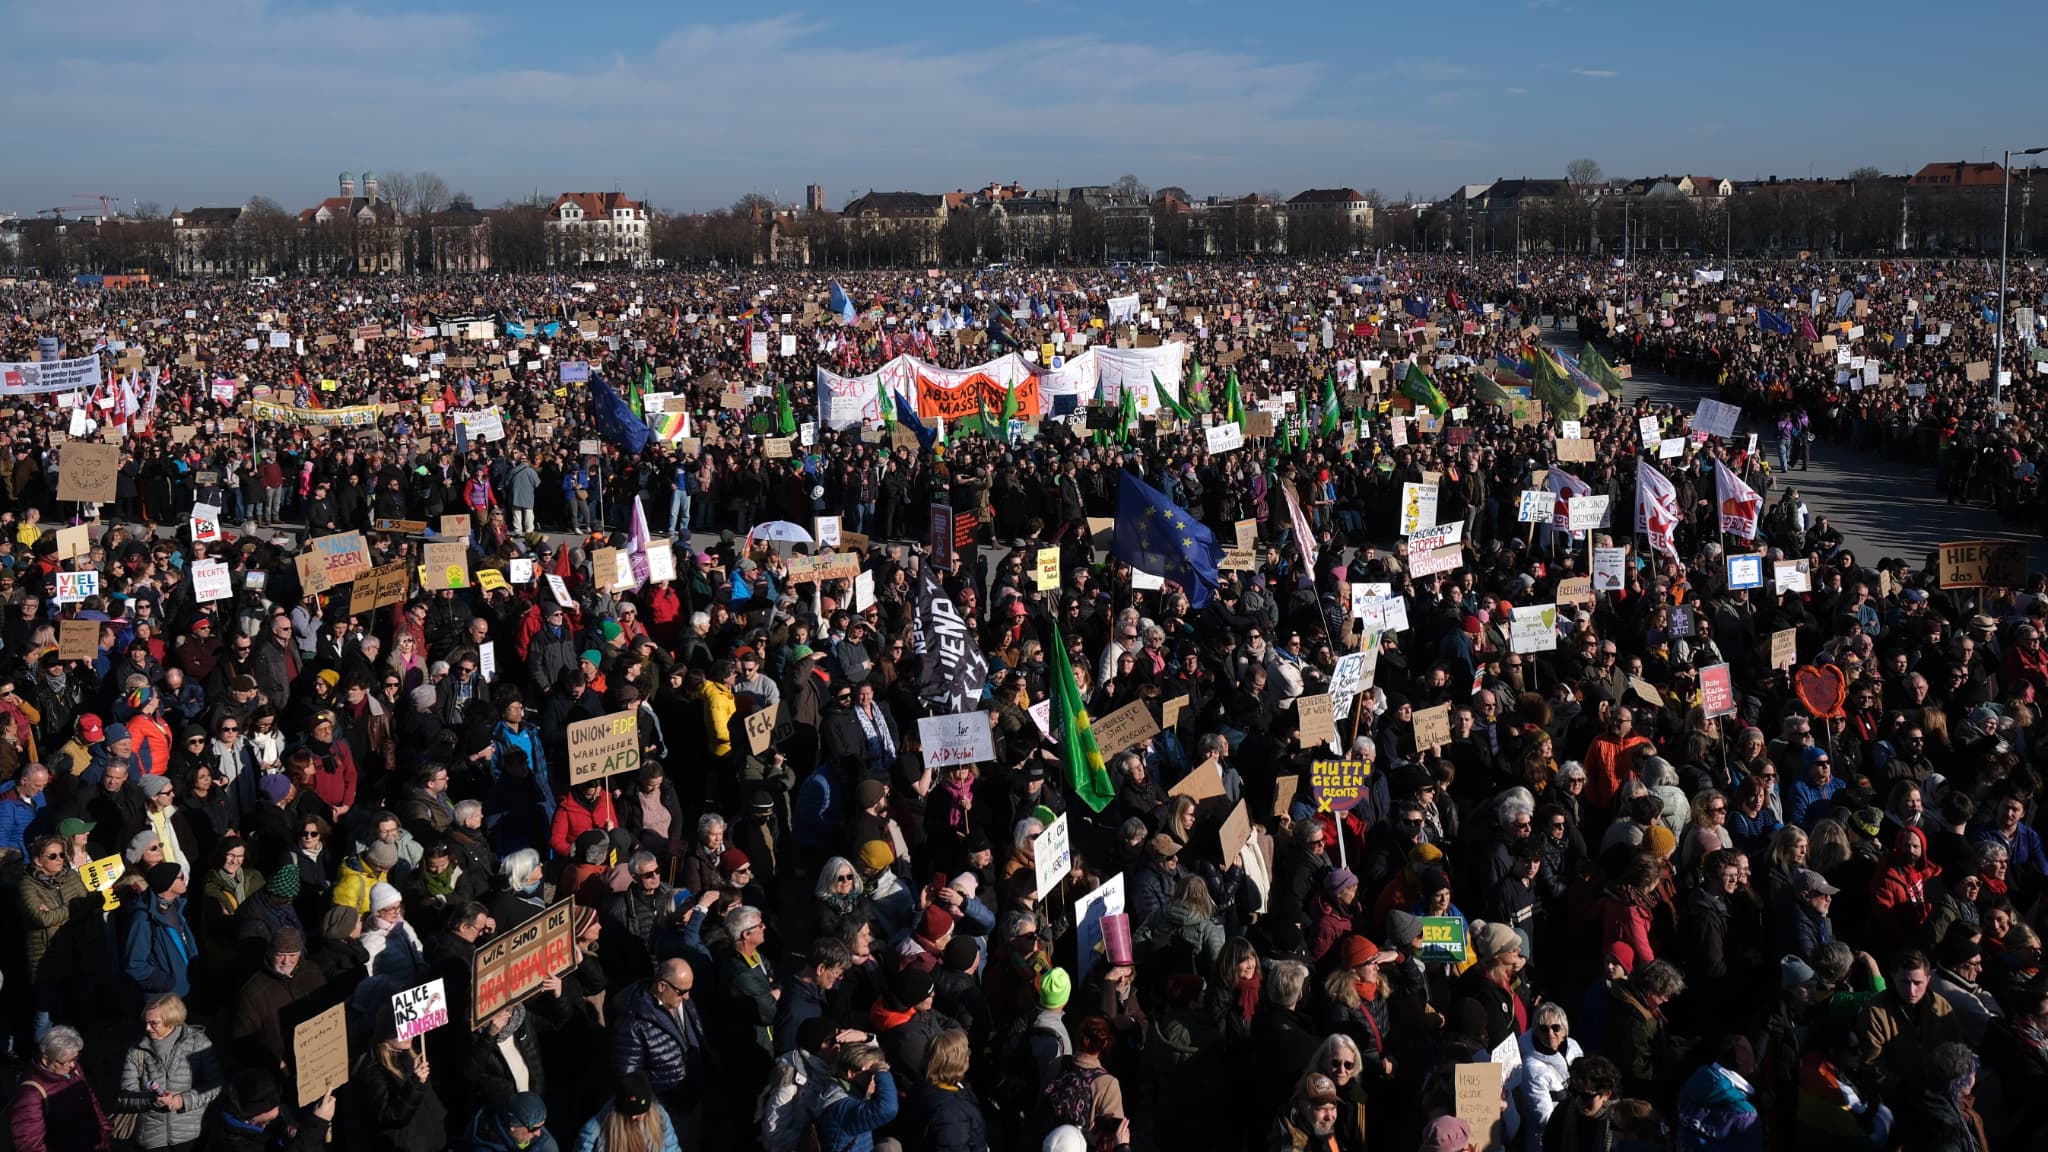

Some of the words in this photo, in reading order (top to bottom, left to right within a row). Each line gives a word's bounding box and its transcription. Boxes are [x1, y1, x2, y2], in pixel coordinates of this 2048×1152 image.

[1410, 524, 1453, 540] FASCHISMUS
[1409, 537, 1445, 554] STOPPEN
[1947, 546, 1990, 564] HIER
[60, 574, 96, 585] VIEL
[197, 568, 224, 578] RECHTS
[1951, 566, 1972, 582] das
[60, 585, 95, 596] FALT
[613, 716, 636, 736] FDP
[748, 711, 773, 738] fck
[576, 762, 597, 775] DER
[602, 749, 639, 774] AFD
[1312, 775, 1363, 787] GEGEN
[1323, 787, 1359, 799] RECHTS
[483, 944, 504, 965] WIR
[512, 926, 538, 950] SIND
[547, 910, 565, 930] DIE
[1423, 926, 1452, 941] ERZ
[395, 985, 429, 1011] ALICE
[396, 1006, 418, 1026] INS
